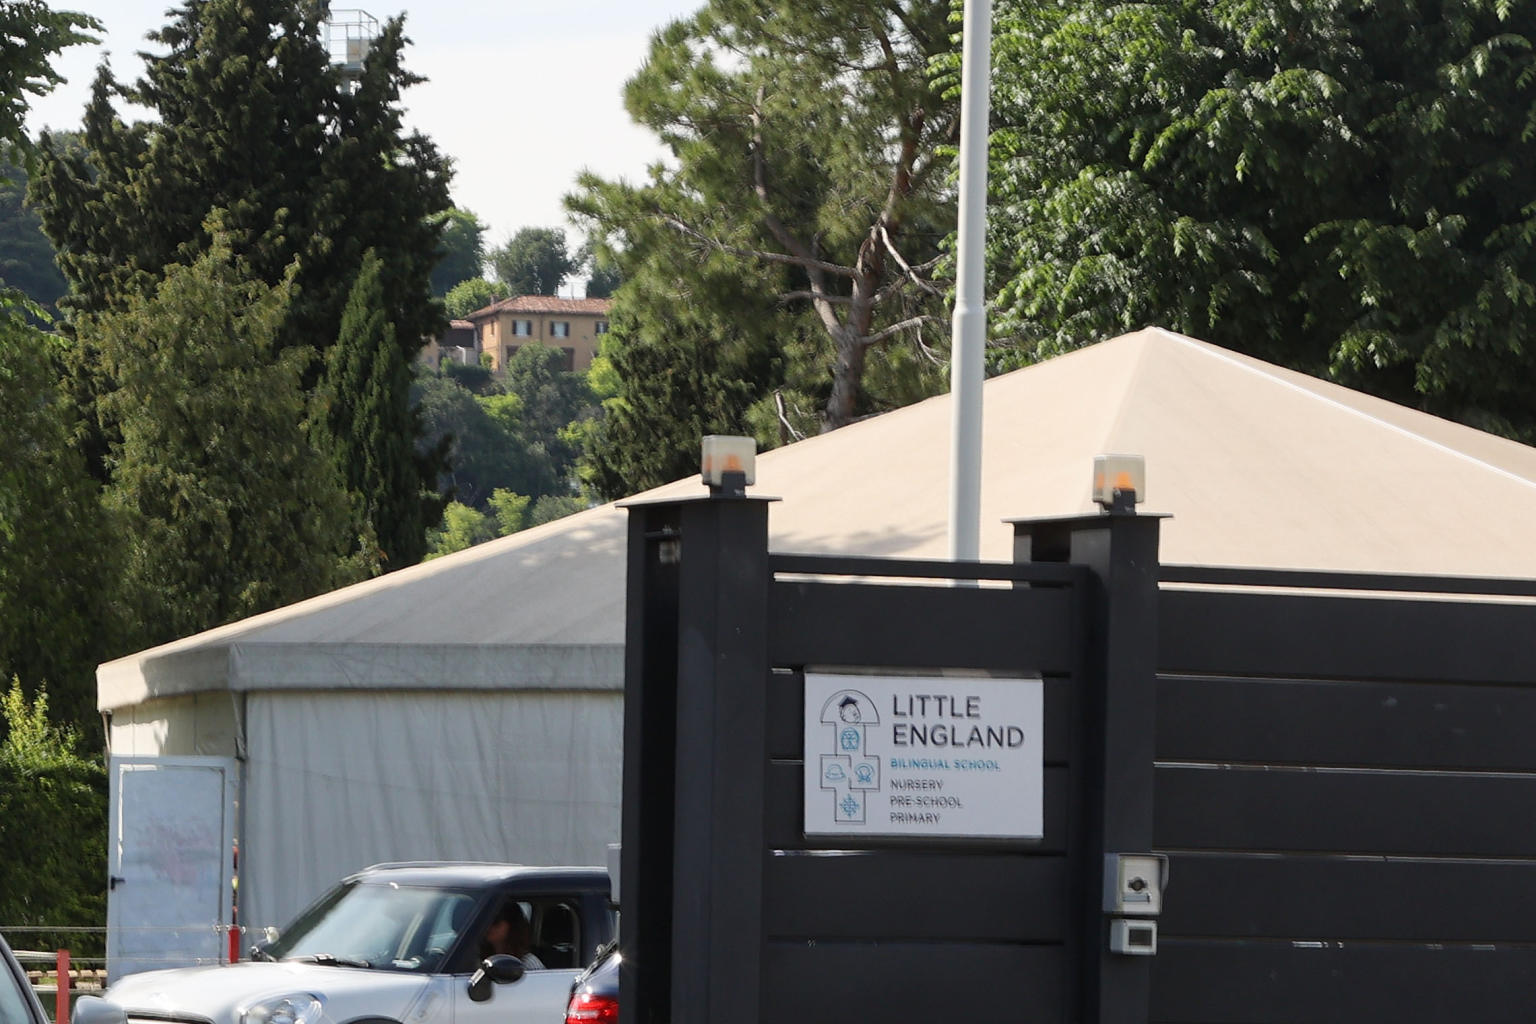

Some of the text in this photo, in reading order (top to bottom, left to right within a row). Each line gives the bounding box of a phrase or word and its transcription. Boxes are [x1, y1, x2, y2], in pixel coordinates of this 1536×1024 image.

[892, 694, 982, 719] LITTLE
[892, 723, 1025, 749] ENGLAND
[890, 758, 1001, 773] BILINGUAL SCHOOL
[890, 779, 944, 791] NURSERY
[890, 811, 941, 825] PRIMARY
